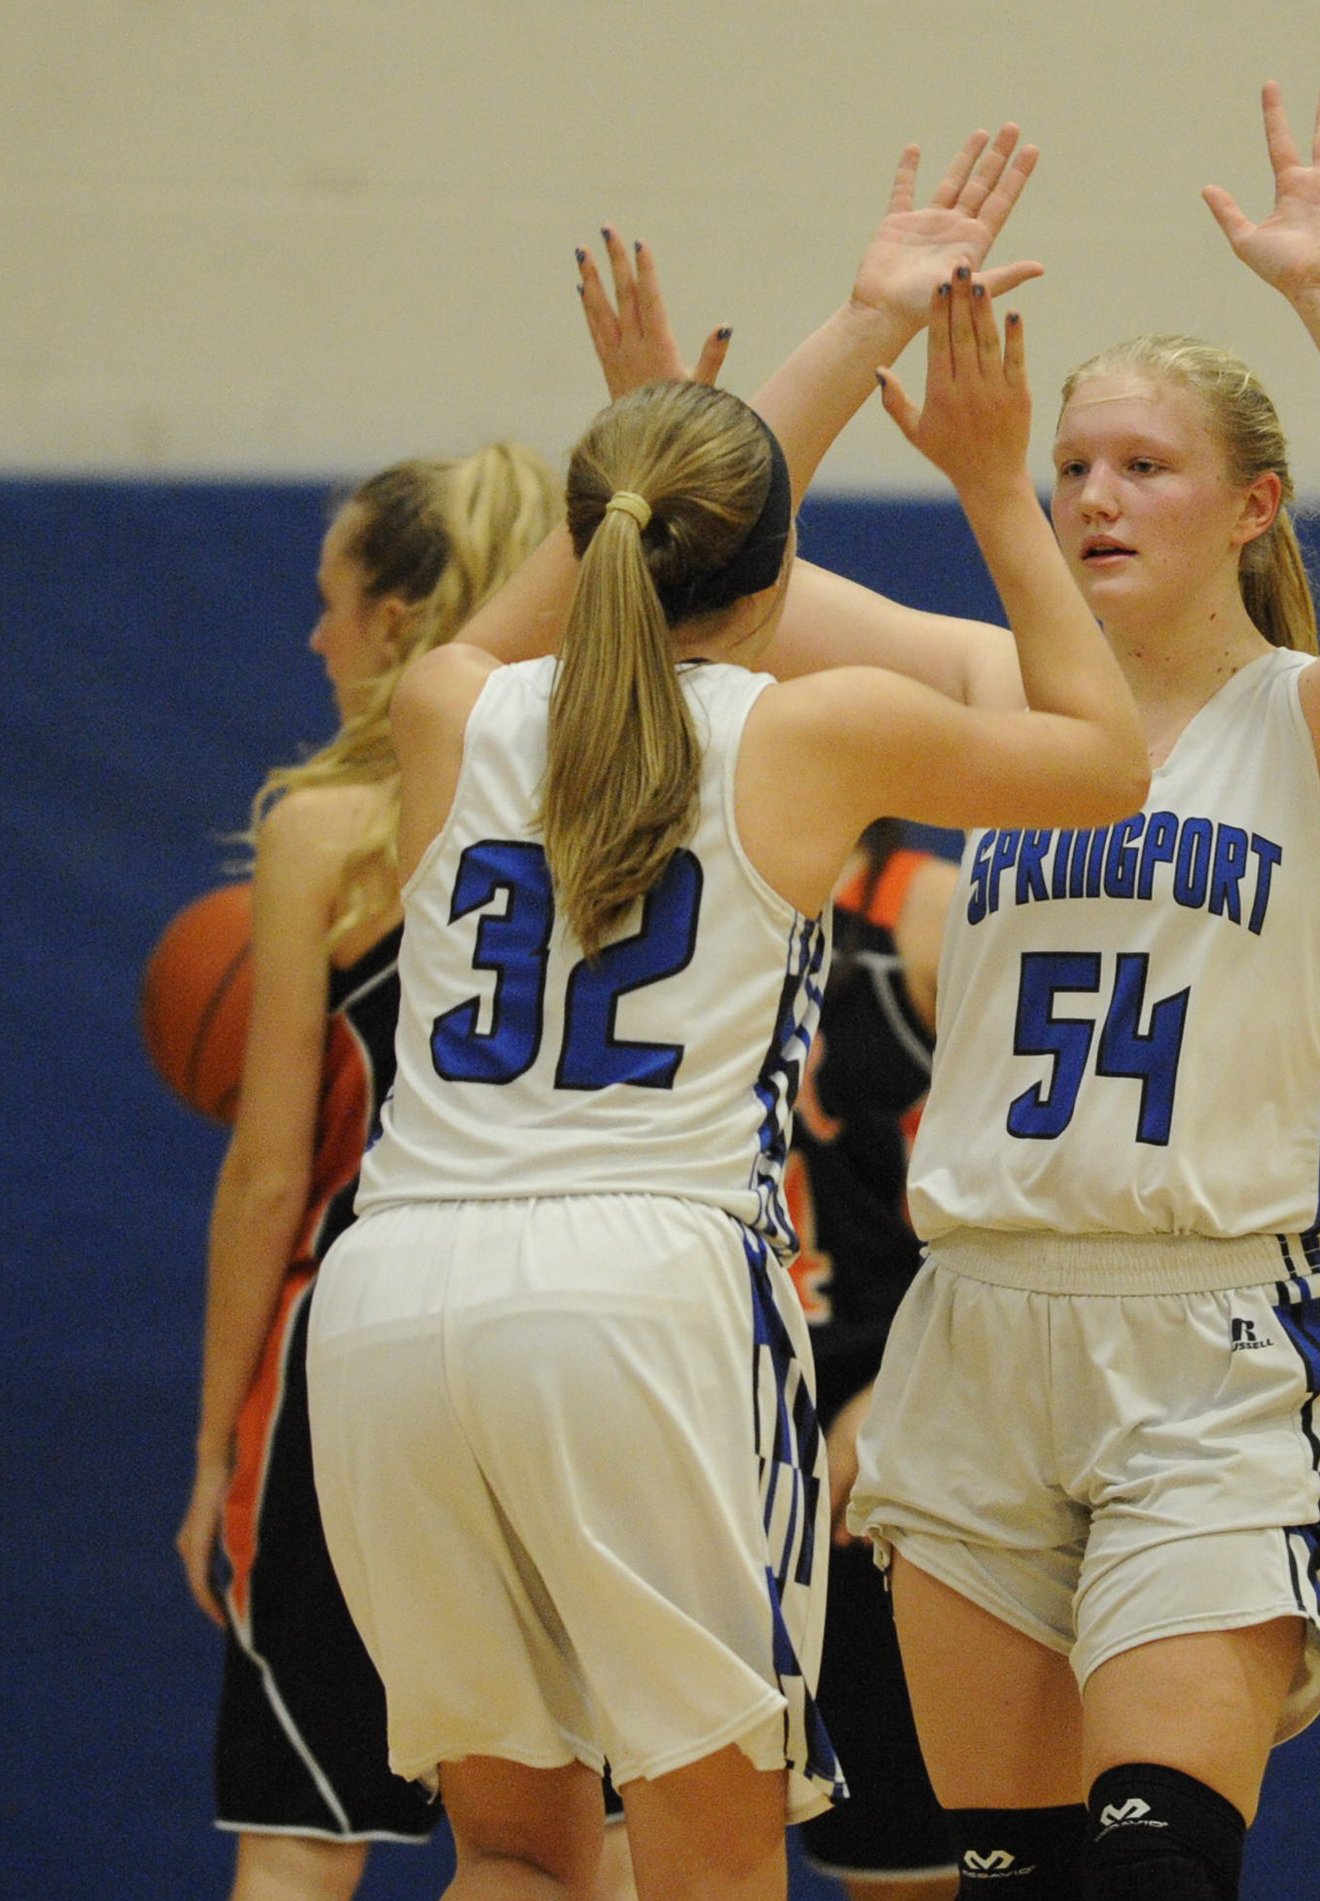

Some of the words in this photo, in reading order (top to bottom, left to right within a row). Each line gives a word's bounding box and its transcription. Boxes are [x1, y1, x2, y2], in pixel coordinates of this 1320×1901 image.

[430, 839, 704, 1091] 32
[967, 811, 1283, 936] SPRINGPORT
[1006, 951, 1191, 1146] 54
